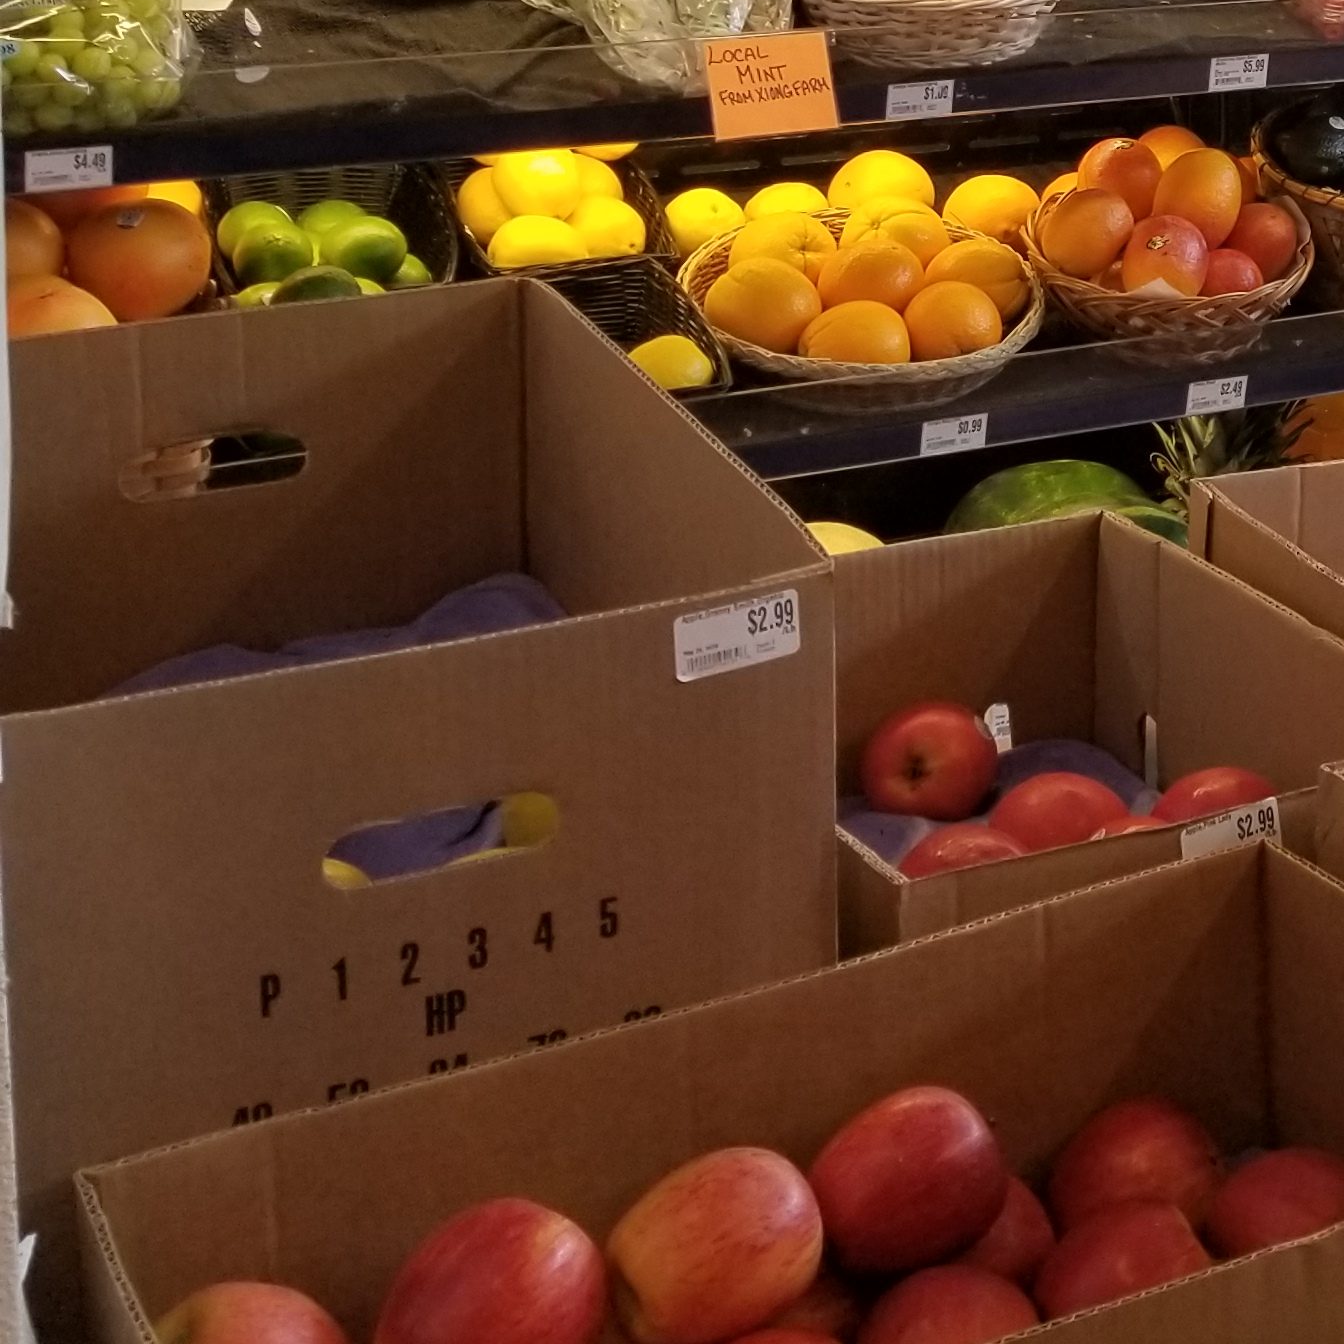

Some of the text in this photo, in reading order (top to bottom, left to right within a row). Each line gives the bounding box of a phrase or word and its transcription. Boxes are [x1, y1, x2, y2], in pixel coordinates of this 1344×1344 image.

[707, 46, 769, 66] LOCAL
[1243, 59, 1265, 73] $5.99
[735, 65, 787, 85] MINT
[718, 76, 830, 107] FROM XIONG FARM
[74, 152, 106, 171] $4.49
[958, 419, 983, 435] $0.99
[747, 598, 794, 637] $2.99
[1237, 806, 1275, 840] $2.99
[260, 897, 620, 1017] P 1 2 3 4 5
[425, 989, 468, 1036] HP
